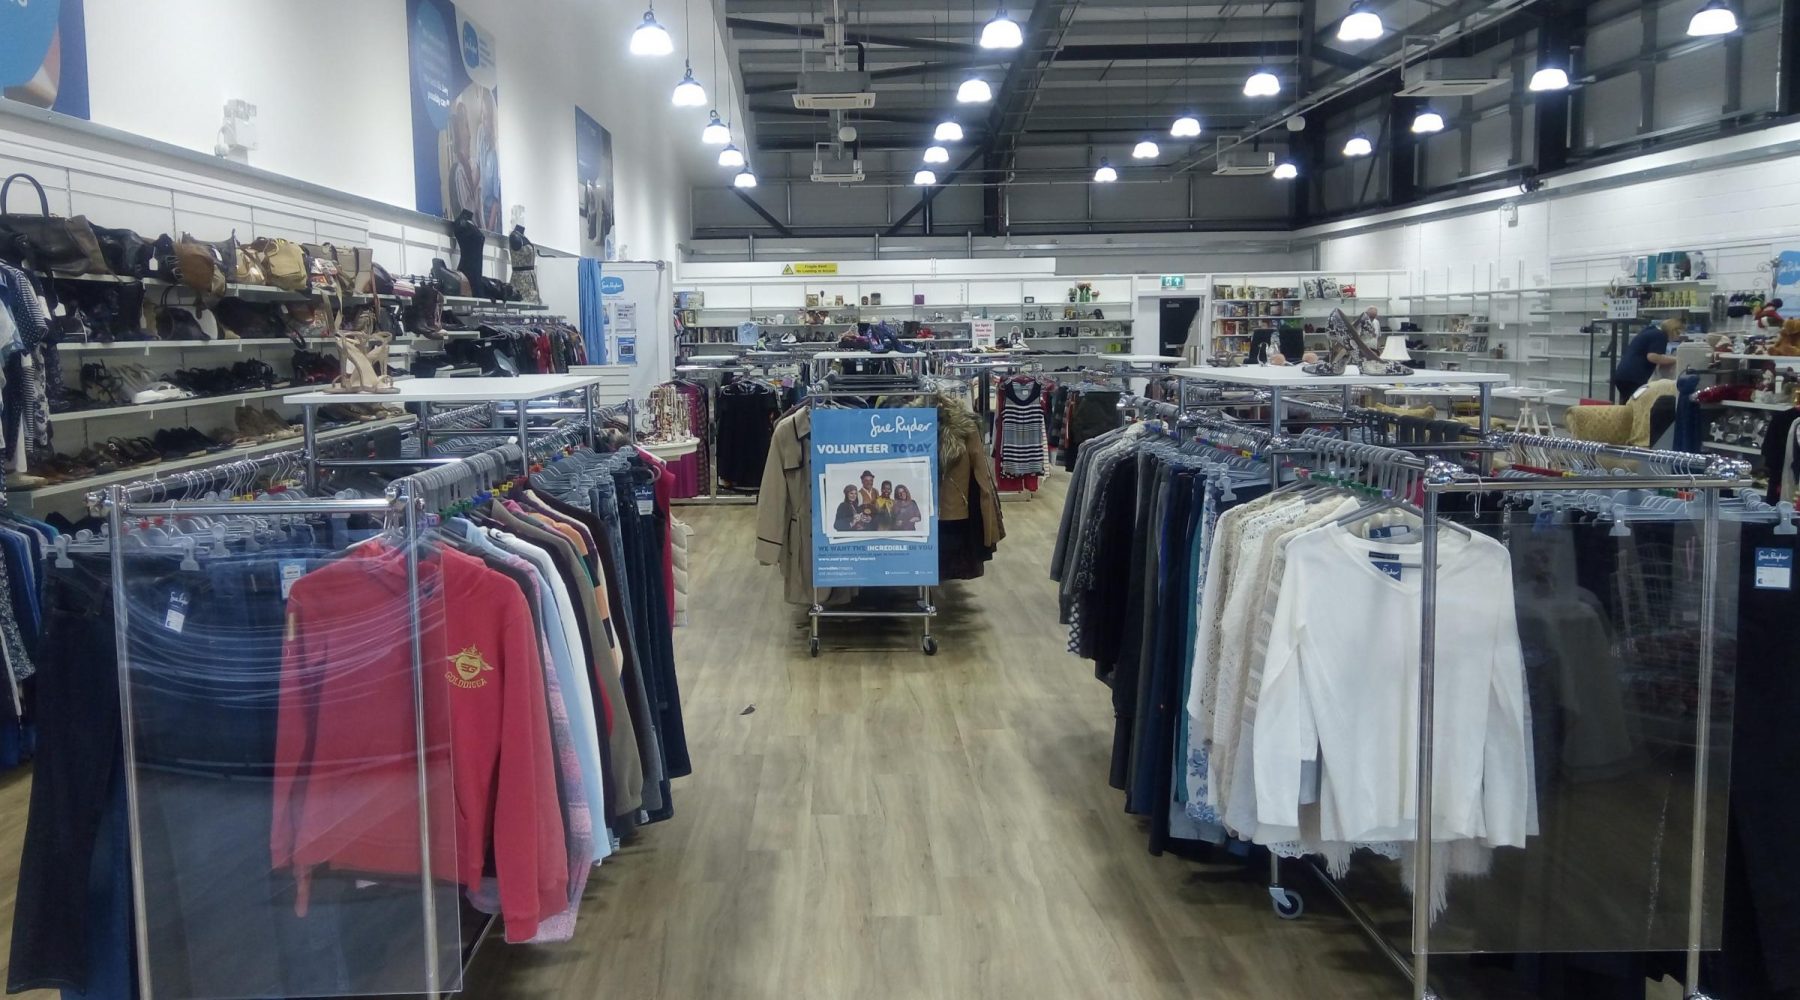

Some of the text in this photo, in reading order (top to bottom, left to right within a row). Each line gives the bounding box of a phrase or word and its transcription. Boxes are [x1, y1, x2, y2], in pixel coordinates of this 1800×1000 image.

[870, 414, 933, 440] Sue Ryder
[816, 443, 932, 454] VOLUNTEER TODAY
[1758, 550, 1789, 563] Sue Ryder
